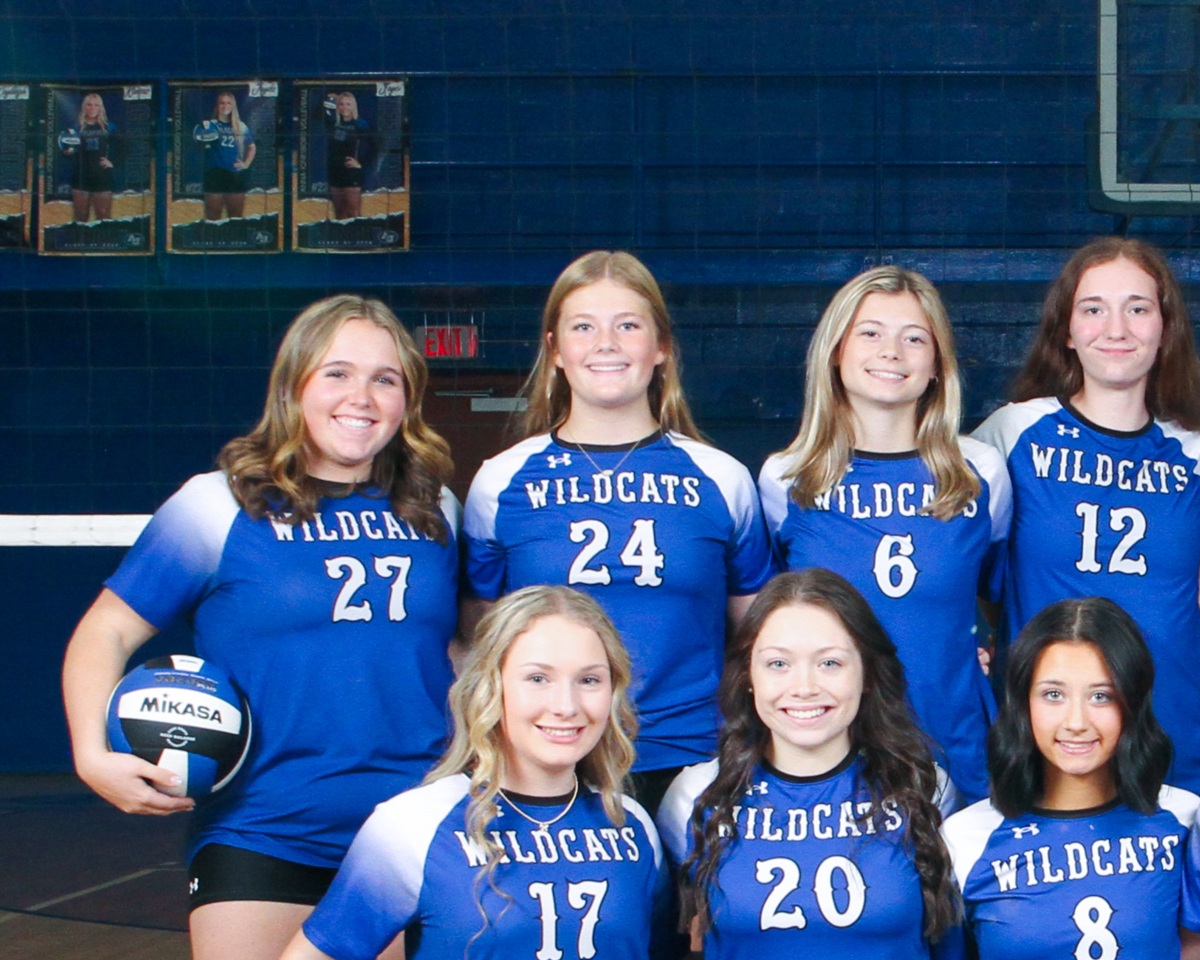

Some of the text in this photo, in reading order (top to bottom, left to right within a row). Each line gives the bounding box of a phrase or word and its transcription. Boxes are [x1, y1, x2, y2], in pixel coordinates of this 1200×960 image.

[425, 328, 462, 356] EXIT
[525, 473, 701, 509] WILDCATS
[1030, 442, 1188, 494] WILDCATS
[269, 510, 434, 542] WILDCA
[814, 482, 978, 519] WILDCAS
[569, 518, 664, 587] 24
[872, 532, 921, 599] 6
[1075, 502, 1148, 576] 12
[324, 555, 412, 622] 27
[454, 827, 640, 867] WILDCATS
[992, 835, 1180, 892] WILDCATS
[755, 855, 867, 931] 20
